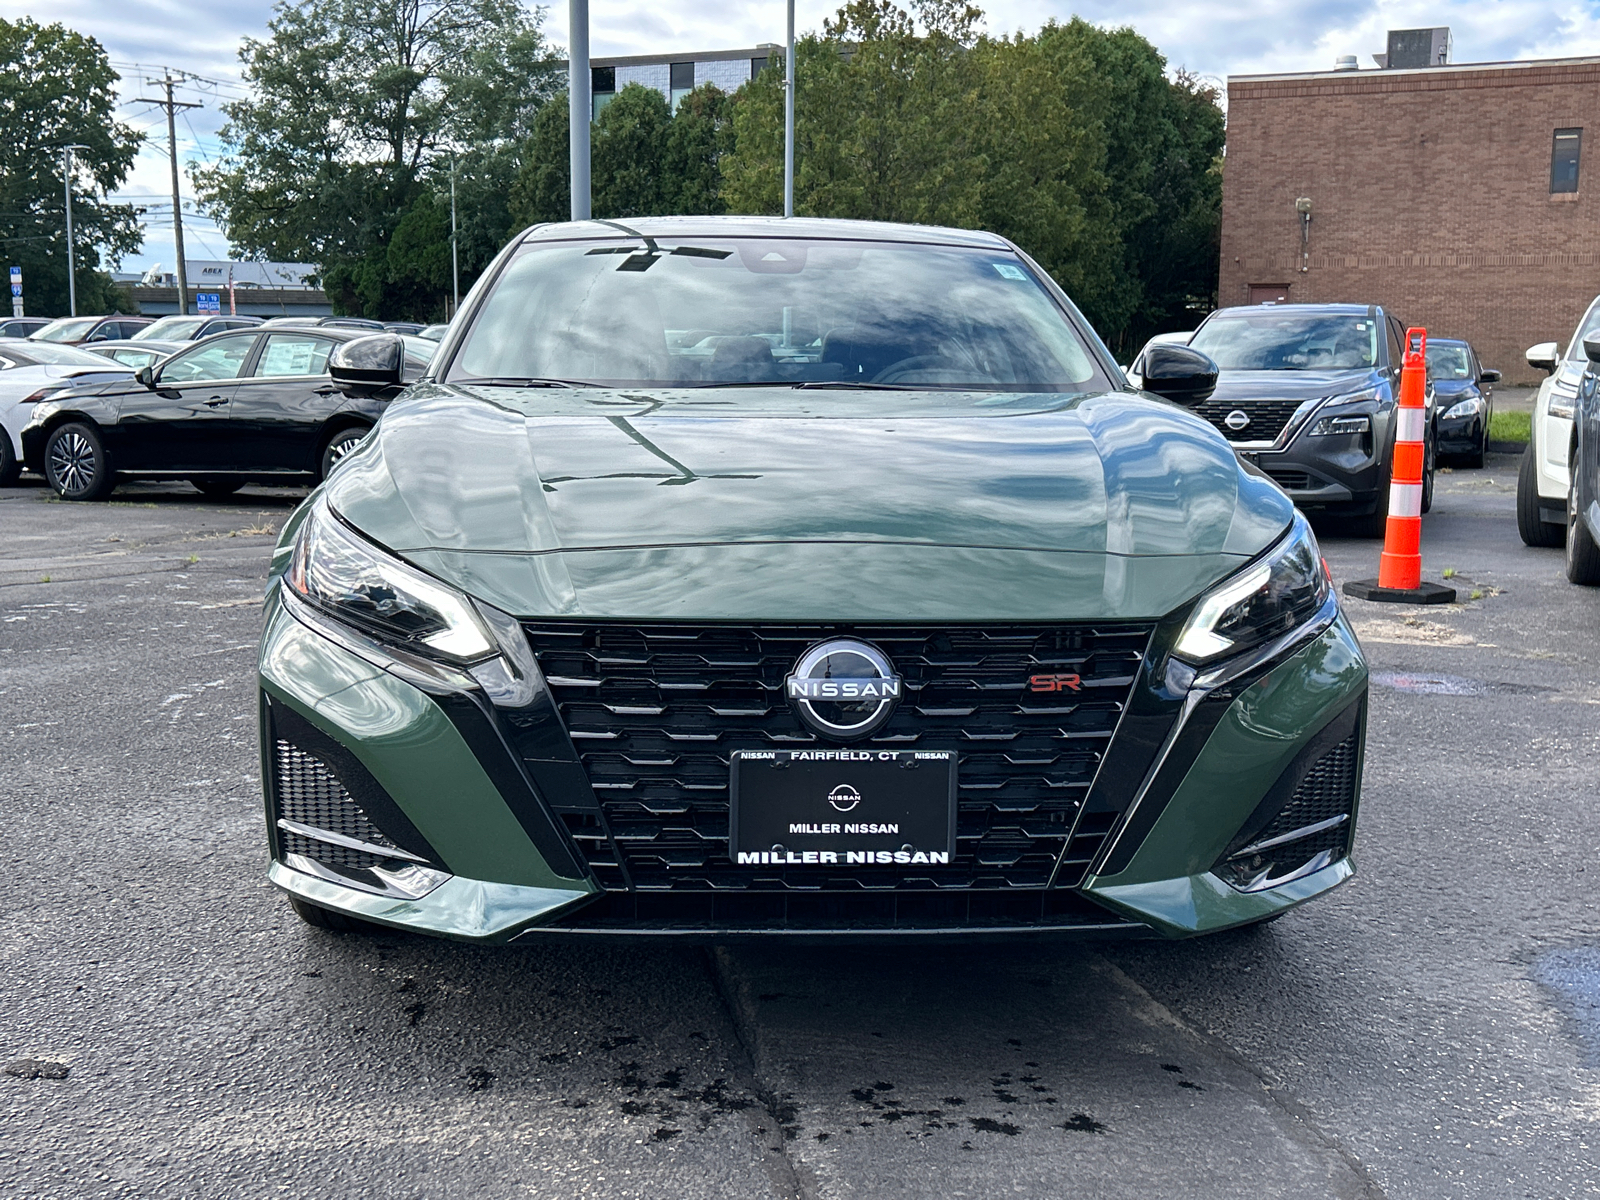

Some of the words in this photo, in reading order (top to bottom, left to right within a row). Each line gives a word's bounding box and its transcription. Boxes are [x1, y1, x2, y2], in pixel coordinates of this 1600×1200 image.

[1031, 674, 1081, 691] SR
[791, 682, 898, 696] NISSAN
[741, 752, 775, 760] NISSAN
[790, 751, 874, 762] FAIRFIELD,
[878, 751, 899, 761] CT
[914, 752, 949, 760] NISSAN
[789, 823, 841, 834] MILLER
[844, 823, 899, 834] NISSAN
[737, 851, 838, 864] MILLER
[846, 851, 949, 864] NISSAN
